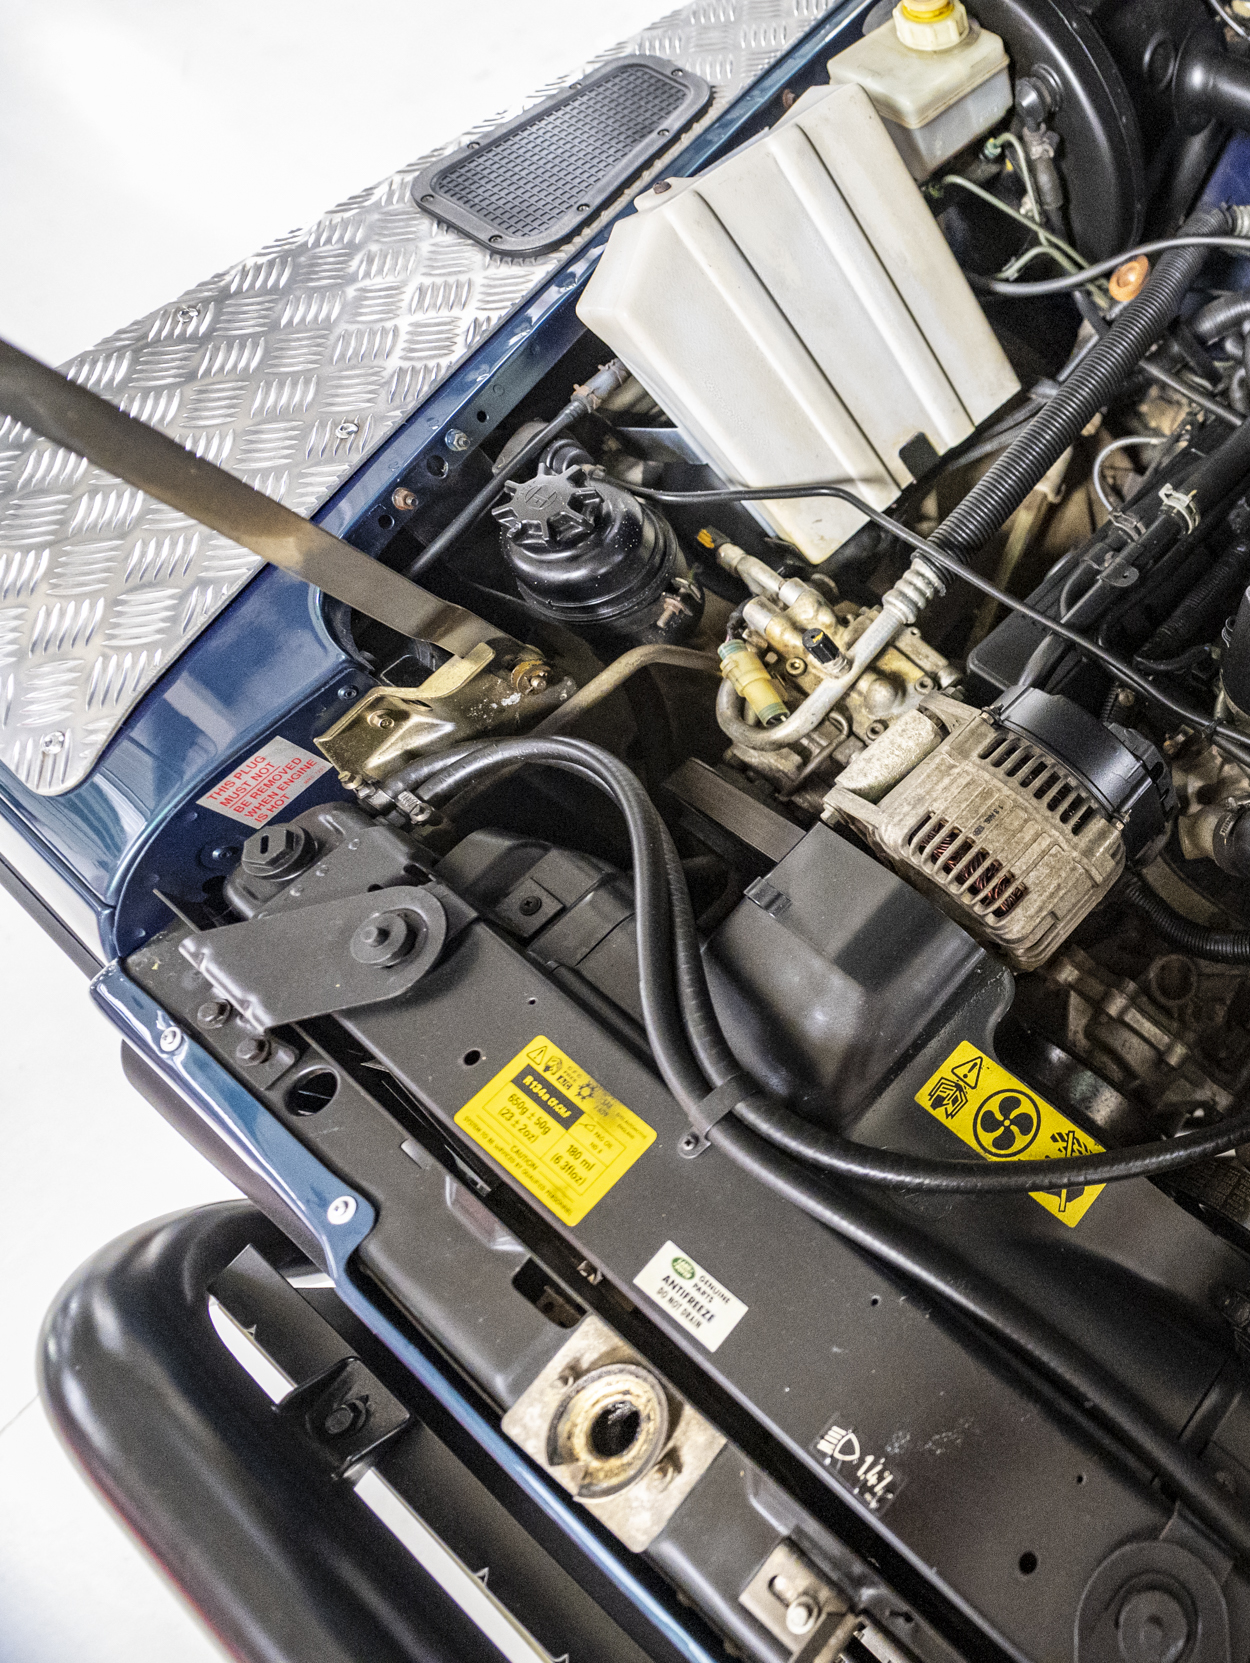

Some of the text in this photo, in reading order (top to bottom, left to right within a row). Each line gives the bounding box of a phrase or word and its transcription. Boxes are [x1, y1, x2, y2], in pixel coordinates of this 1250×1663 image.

[207, 755, 266, 801] THIS PLUG
[220, 762, 275, 807] MUST NOT
[233, 757, 302, 814] BE REMOVED
[244, 759, 317, 818] WHEN ENGINE
[255, 794, 290, 823] IS HOT
[497, 1106, 514, 1122] (23
[517, 1123, 538, 1144] 2oz)
[506, 1093, 530, 1116] 650g
[532, 1116, 551, 1135] 50g
[463, 1116, 481, 1133] SYSTEM
[479, 1130, 488, 1139] TO
[487, 1137, 495, 1145] BE
[521, 1169, 545, 1191] QUALIFIED
[510, 1145, 537, 1170] CAUTION
[566, 1144, 595, 1171] 180 ml
[656, 1286, 702, 1328] DO NOT DRAIN
[662, 1275, 714, 1321] ANTIFREEZE
[692, 1282, 714, 1303] PARTS
[698, 1275, 730, 1304] GENUINE
